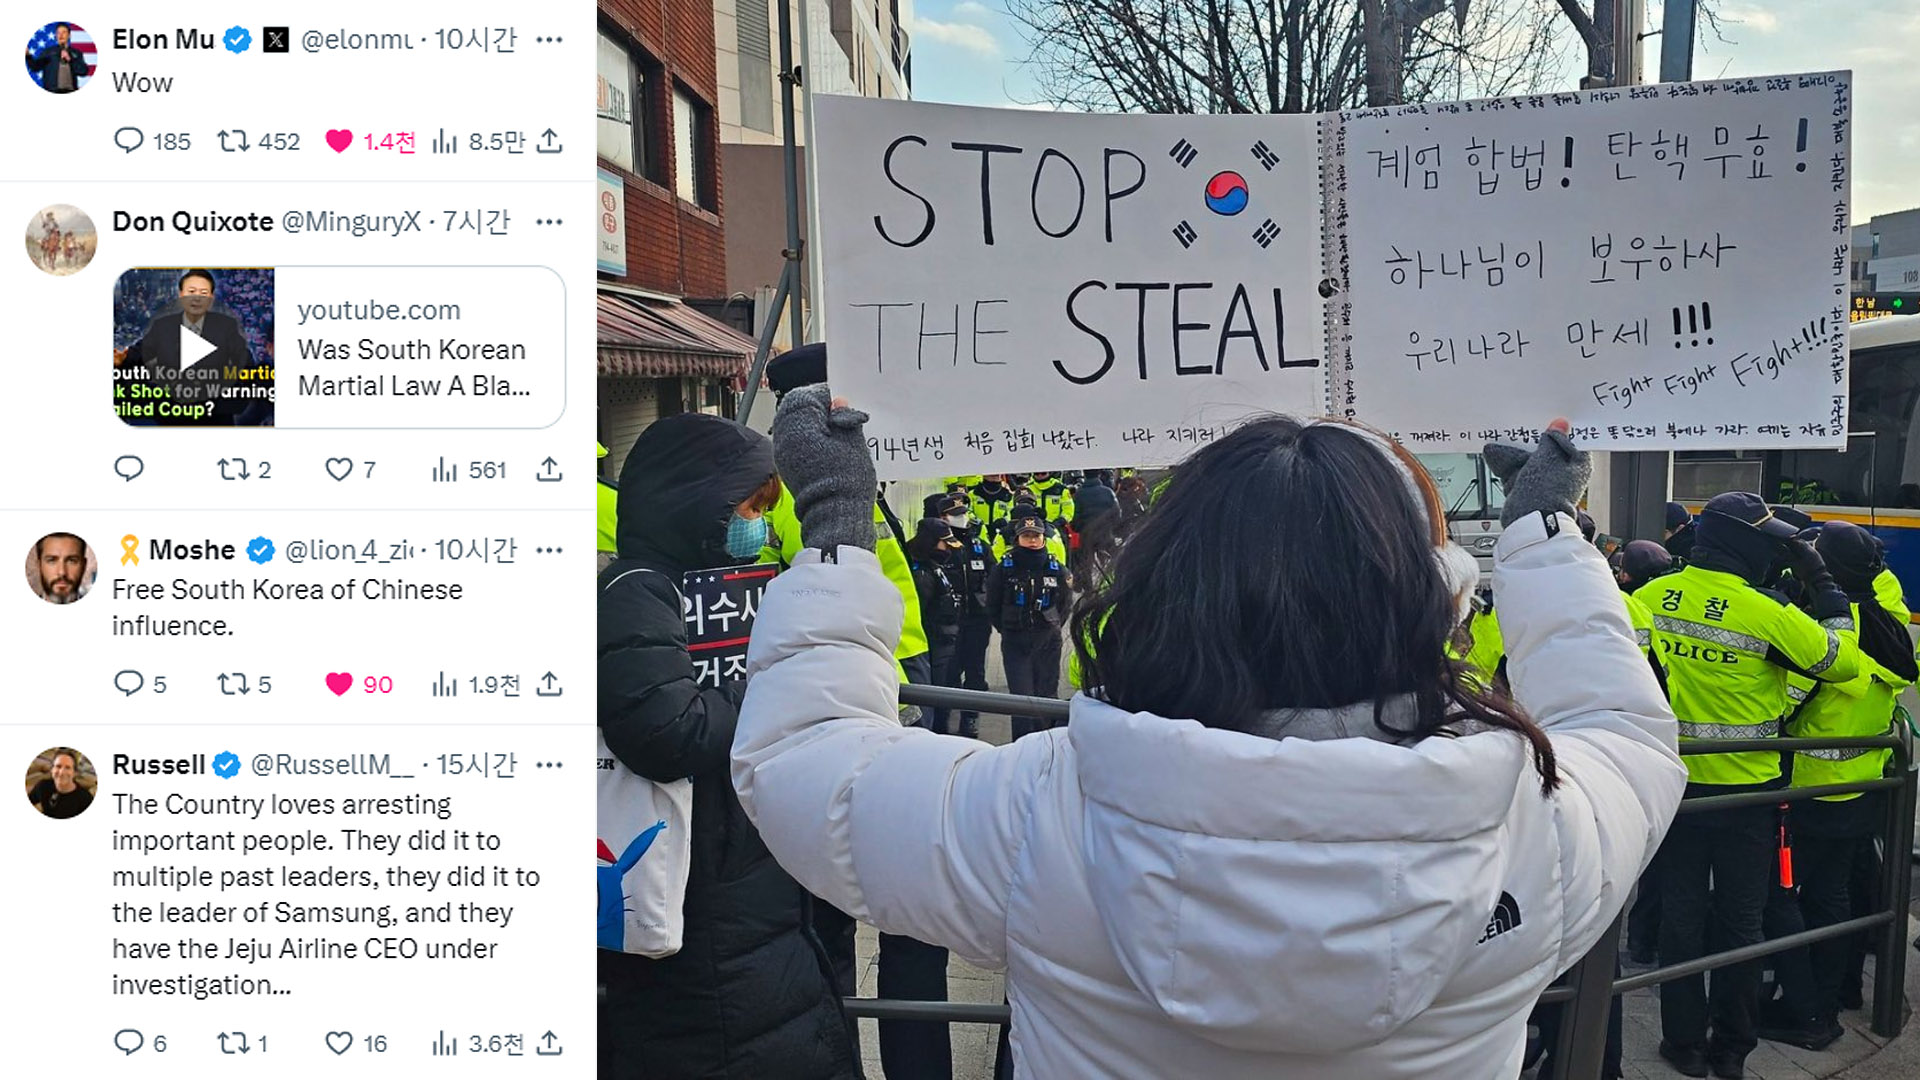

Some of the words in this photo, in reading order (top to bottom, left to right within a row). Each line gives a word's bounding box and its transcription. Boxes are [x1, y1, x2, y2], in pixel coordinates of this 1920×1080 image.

[113, 28, 168, 50] Elon
[176, 28, 216, 50] Mu
[435, 27, 519, 54] 10시간
[112, 72, 174, 93] Wow
[1628, 87, 1659, 99] 민주당
[154, 133, 191, 150] 185
[258, 133, 300, 150] 452
[364, 131, 415, 154] 1.4천
[469, 131, 526, 154] 8.5만
[1367, 143, 1441, 190] 계엄
[1607, 129, 1689, 181] 탄핵
[873, 134, 1147, 248] STOP
[113, 211, 164, 232] Don
[172, 211, 274, 235] Quixote
[282, 211, 421, 238] @MinguryX
[443, 209, 511, 236] 7시간
[1832, 200, 1848, 235] 우리가
[1385, 240, 1544, 290] 하나님이
[1590, 232, 1738, 284] 보우하사
[1832, 244, 1848, 276] 나라는
[1833, 283, 1846, 295] 이
[297, 299, 460, 325] youtube.com
[849, 299, 1010, 373] THE
[1052, 280, 1320, 384] STEAL
[297, 339, 350, 360] Was
[358, 339, 430, 360] South
[440, 339, 525, 360] Korean
[1405, 329, 1532, 372] 우리나라
[155, 366, 219, 380] Korean
[131, 384, 171, 399] Shot
[175, 384, 201, 398] for
[299, 375, 383, 396] Martial
[392, 375, 441, 396] Law
[447, 375, 466, 396] A
[473, 375, 530, 396] Bla...
[1592, 375, 1653, 409] Fight
[1664, 364, 1717, 395] Fight
[159, 401, 216, 419] Coup?
[1459, 431, 1471, 441] 이
[1478, 429, 1502, 442] 나라
[1665, 423, 1707, 439] 북에나
[1799, 424, 1826, 437] 자유
[867, 434, 945, 462] 94년생
[963, 429, 995, 455] 처음
[1002, 428, 1035, 452] 집회
[1041, 428, 1100, 451] 나왔다.
[1122, 428, 1156, 444] 나라
[1166, 427, 1217, 444] 지키러
[259, 461, 271, 479] 2
[364, 461, 376, 478] 7
[469, 461, 505, 479] 561
[150, 539, 235, 560] Moshe
[435, 537, 518, 564] 10시간
[113, 579, 165, 599] Free
[172, 579, 244, 599] South
[253, 579, 324, 600] Korea
[331, 579, 356, 599] of
[362, 579, 463, 600] Chinese
[113, 615, 233, 636] influence.
[154, 676, 167, 693] 5
[259, 676, 272, 693] 5
[364, 676, 393, 693] 90
[469, 675, 520, 697] 1.9천
[113, 754, 205, 775] Russell
[437, 752, 518, 779] 15시간
[112, 793, 158, 814] The
[166, 793, 264, 820] Country
[272, 794, 335, 814] loves
[342, 793, 452, 820] arresting
[113, 830, 235, 856] important
[243, 830, 334, 856] people.
[341, 829, 401, 856] They
[408, 830, 445, 850] did
[454, 830, 470, 850] it
[475, 831, 500, 850] to
[113, 866, 213, 892] multiple
[221, 867, 274, 892] past
[282, 866, 379, 890] leaders,
[386, 866, 441, 892] they
[447, 866, 484, 886] did
[493, 866, 509, 886] it
[515, 868, 540, 886] to
[112, 902, 152, 922] the
[160, 902, 237, 922] leader
[243, 902, 269, 922] of
[275, 902, 398, 928] Samsung,
[405, 902, 451, 922] and
[458, 902, 514, 928] they
[113, 938, 171, 959] have
[177, 938, 218, 959] the
[224, 938, 271, 964] Jeju
[279, 938, 358, 959] Airline
[364, 938, 418, 959] CEO
[426, 938, 498, 959] under
[113, 974, 291, 1000] investigation...
[153, 1035, 167, 1052] 6
[259, 1035, 267, 1052] 1
[364, 1035, 387, 1052] 16
[469, 1034, 524, 1056] 3.6천
